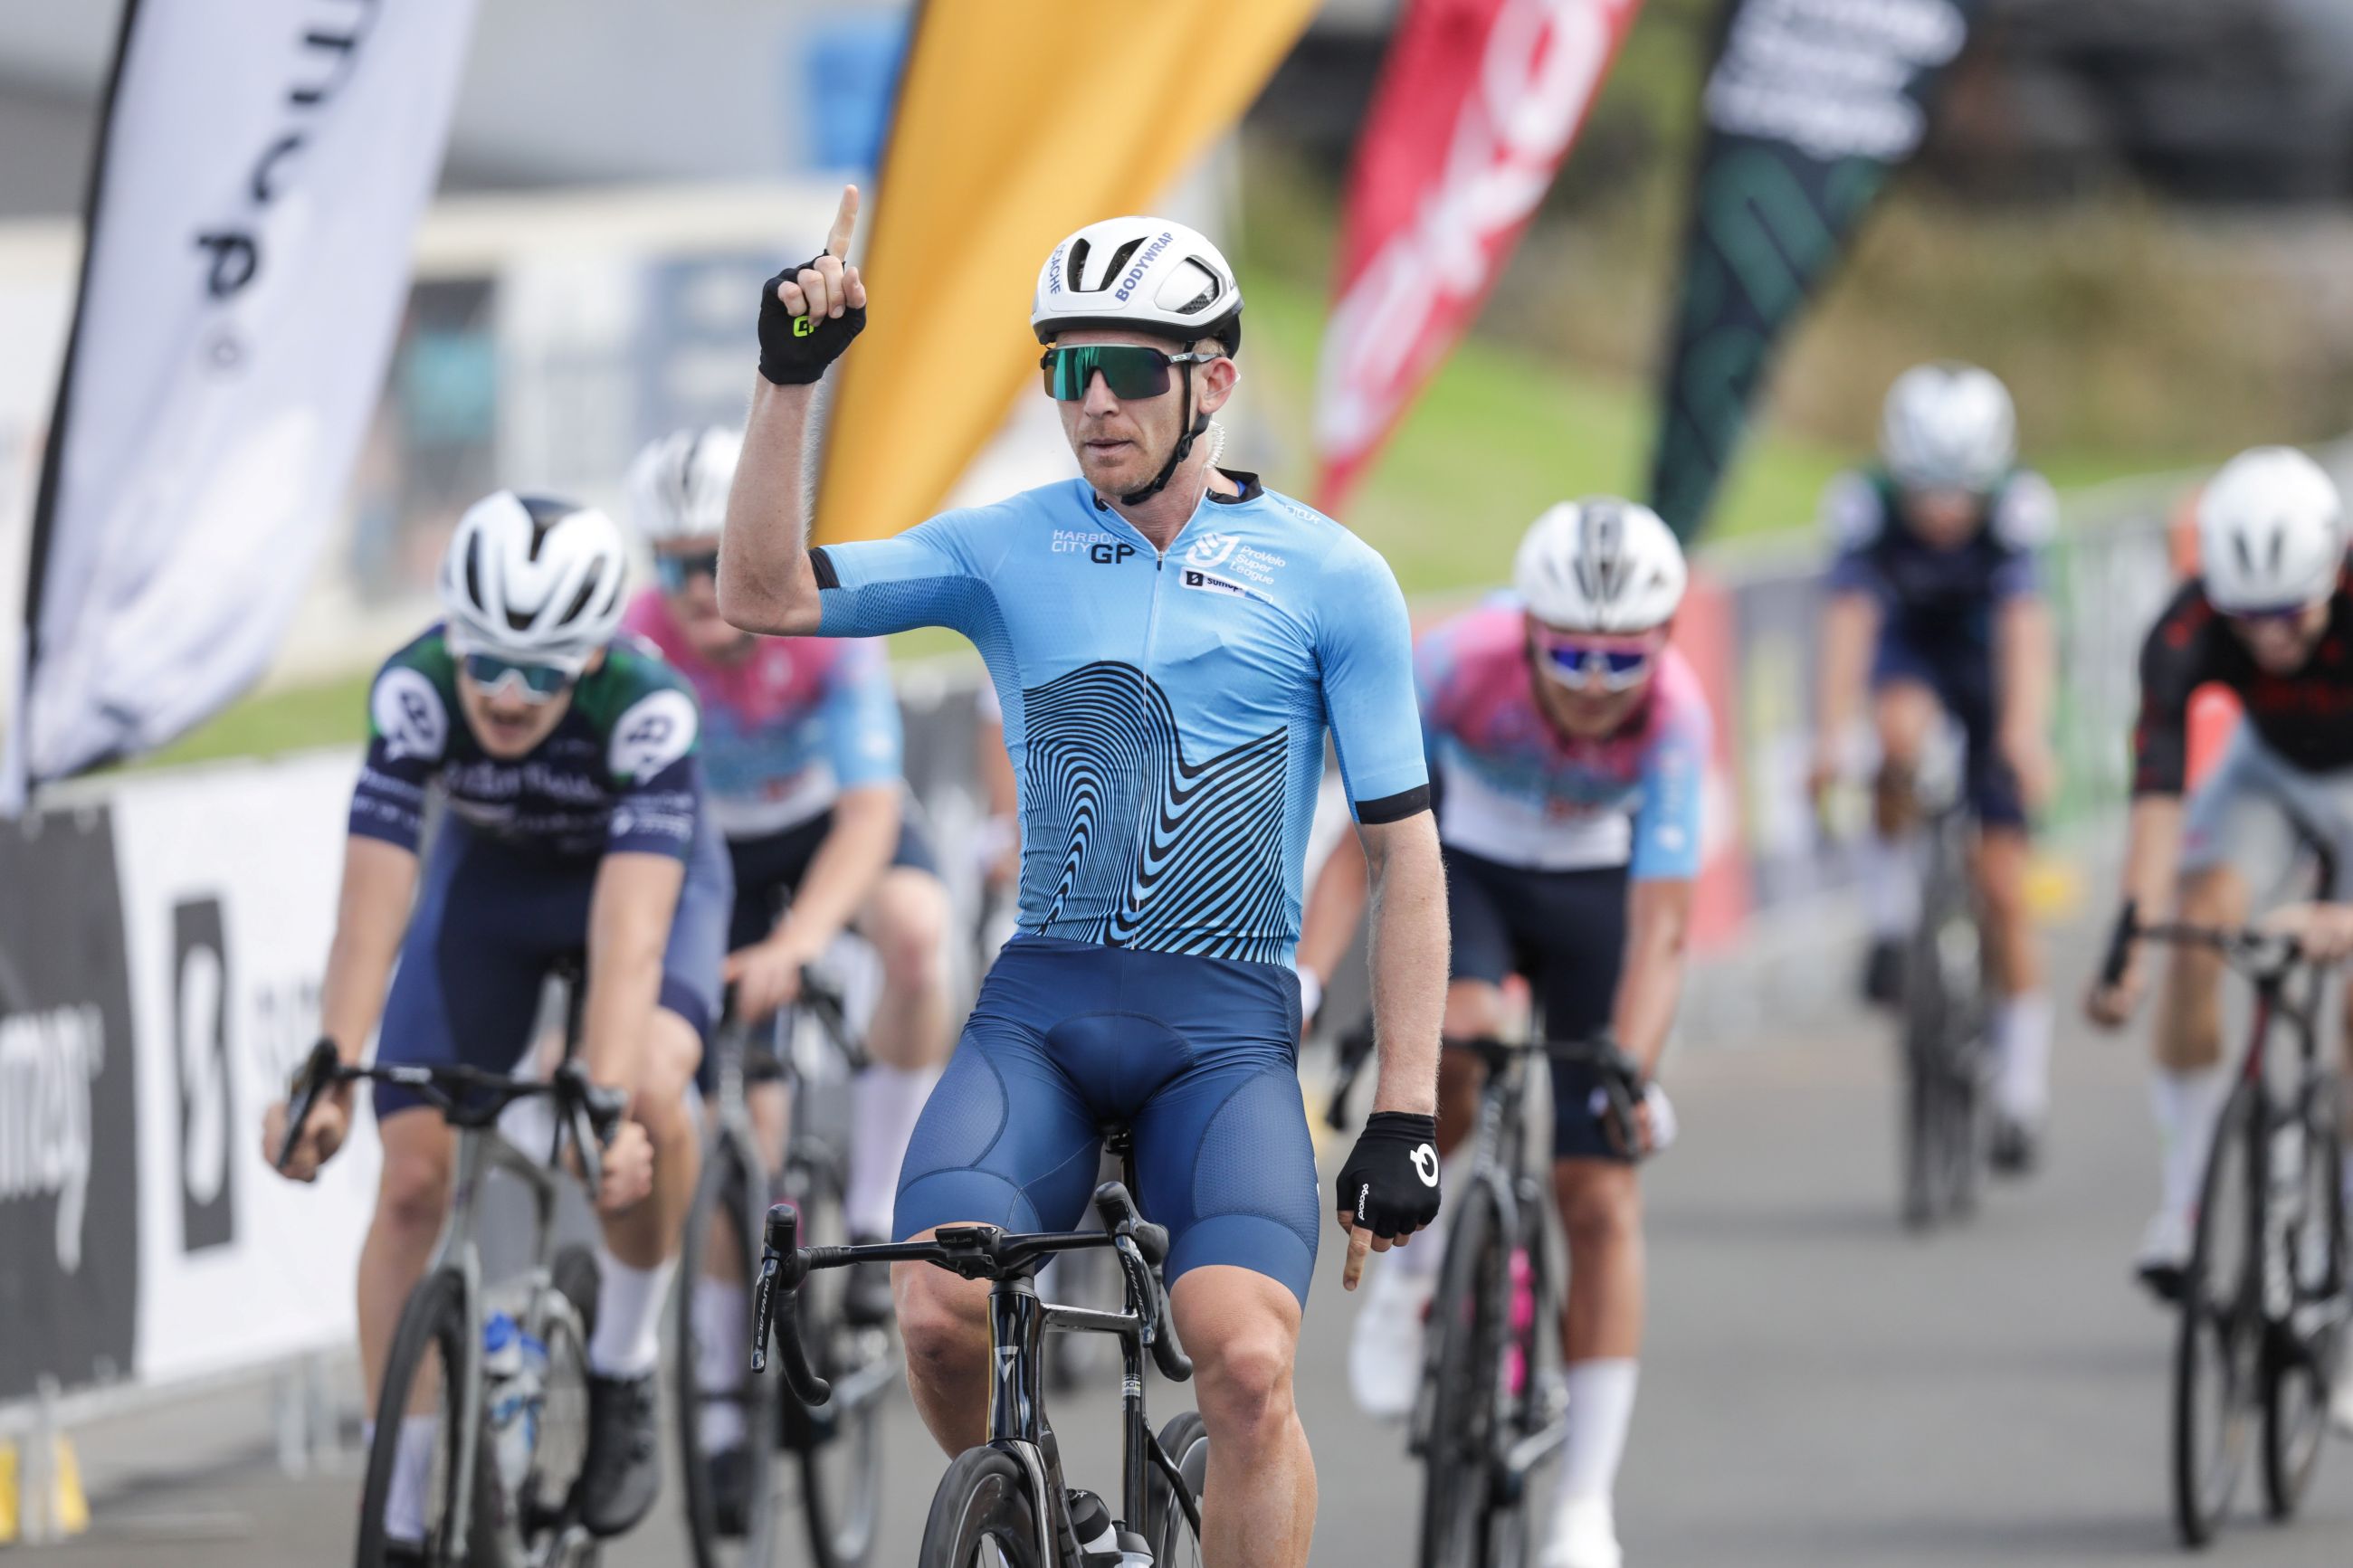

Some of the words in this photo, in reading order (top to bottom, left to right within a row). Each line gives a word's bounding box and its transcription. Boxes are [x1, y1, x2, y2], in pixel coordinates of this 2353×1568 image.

[1115, 232, 1174, 302] BODYWRAP
[1052, 540, 1091, 553] CITY
[1091, 543, 1136, 565] GP
[1241, 545, 1287, 567] ProVelo
[1229, 561, 1275, 585] League
[1235, 554, 1274, 573] Super
